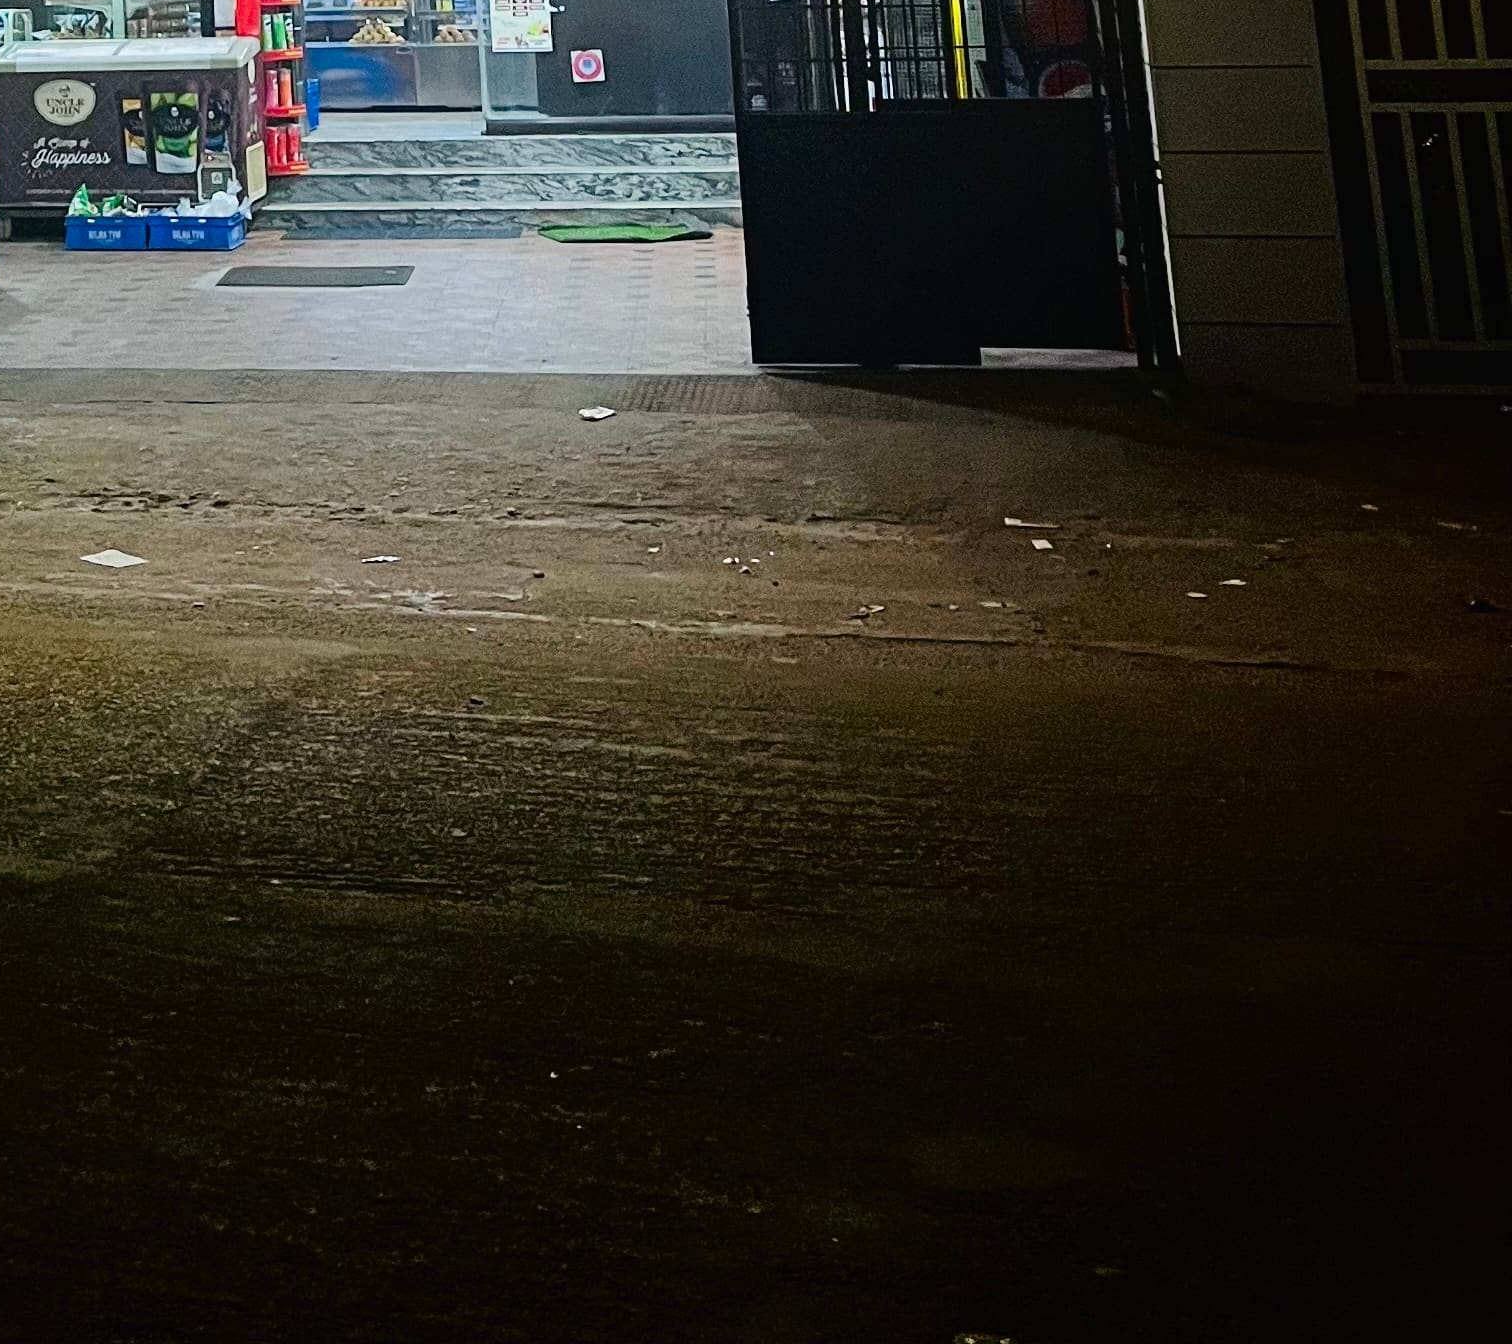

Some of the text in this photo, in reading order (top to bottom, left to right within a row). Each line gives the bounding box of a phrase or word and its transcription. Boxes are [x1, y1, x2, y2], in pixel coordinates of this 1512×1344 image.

[46, 98, 85, 107] UNCLE
[49, 105, 81, 115] JOHN
[31, 148, 111, 168] Happiness
